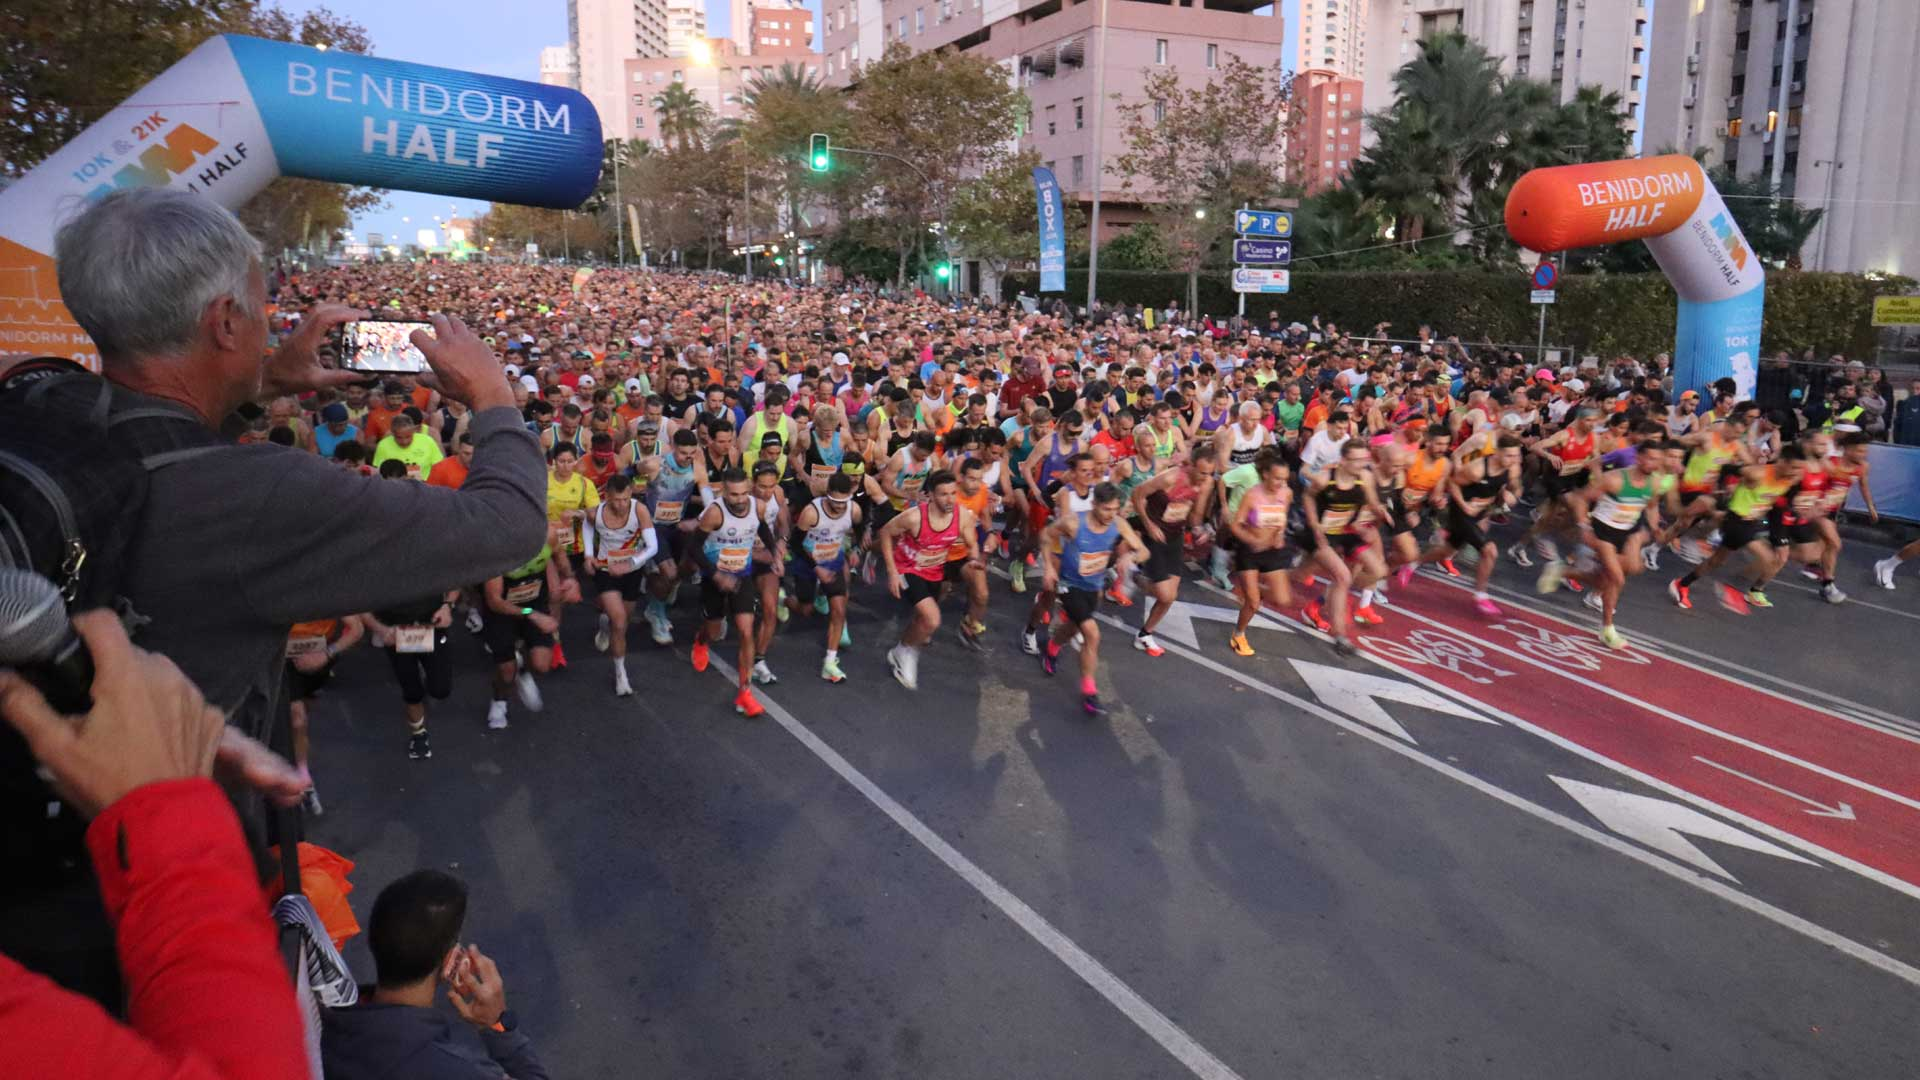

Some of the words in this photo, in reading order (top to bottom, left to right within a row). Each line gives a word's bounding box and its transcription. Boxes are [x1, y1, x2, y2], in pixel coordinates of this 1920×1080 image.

[287, 62, 571, 135] BENIDORM
[72, 152, 113, 184] 10K
[111, 138, 135, 156] &
[131, 111, 169, 142] 21K
[362, 116, 504, 168] HALF
[198, 142, 249, 187] HALF
[1578, 171, 1693, 207] BENIDORM
[1043, 190, 1055, 231] BOX
[1262, 217, 1270, 229] P
[1603, 202, 1665, 232] HALF
[1251, 246, 1274, 254] Casino
[1692, 219, 1726, 265] BENIDORM
[1719, 264, 1741, 287] HALF
[0, 330, 67, 344] NIDORM
[72, 333, 95, 345] HA
[1725, 336, 1749, 348] 10K
[72, 353, 97, 372] 21
